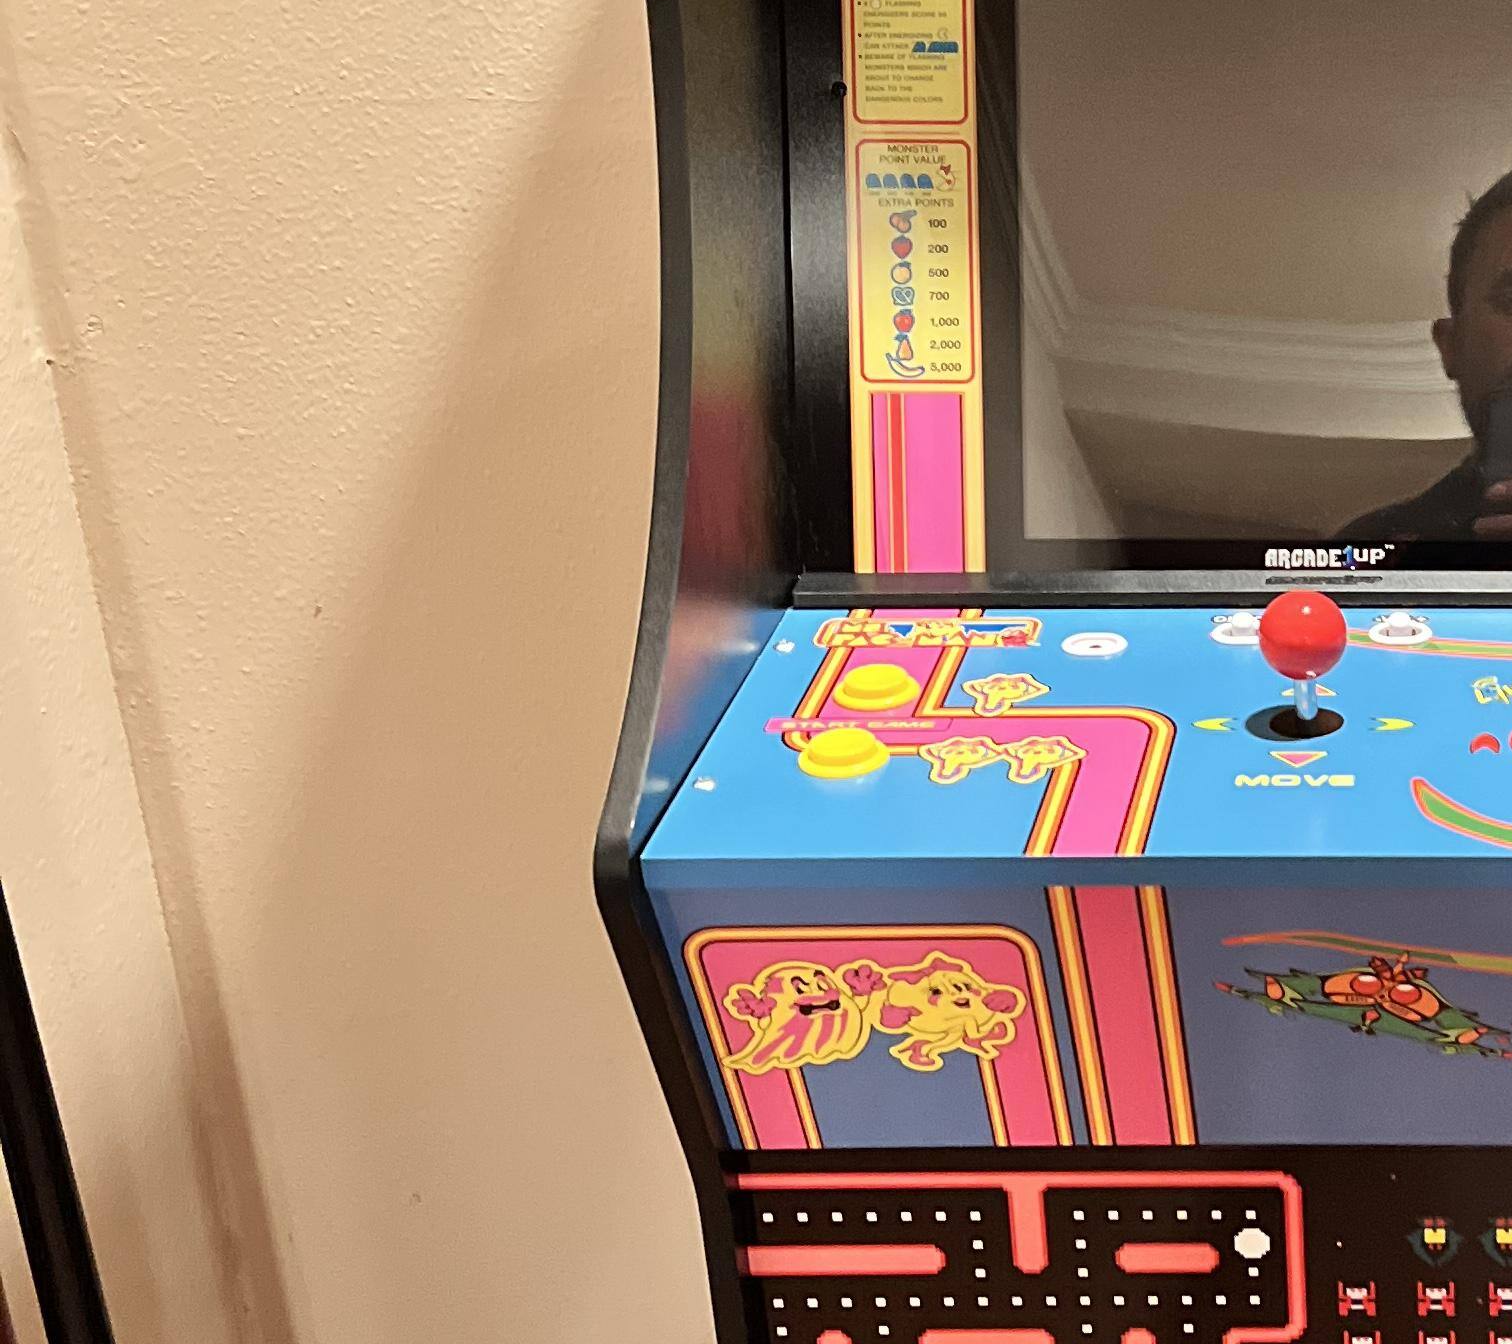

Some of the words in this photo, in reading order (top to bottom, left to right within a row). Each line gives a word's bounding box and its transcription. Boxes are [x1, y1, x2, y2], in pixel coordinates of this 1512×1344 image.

[887, 144, 939, 154] MONSTER
[880, 155, 910, 165] POINT
[913, 155, 945, 165] VALUE
[878, 198, 912, 208] EXTRA
[915, 198, 954, 208] POINTS
[928, 218, 947, 228] 100
[928, 244, 949, 254] 200
[929, 268, 949, 278] 500
[929, 291, 950, 301] 700
[930, 317, 960, 328] 1,000
[1235, 774, 1356, 787] MOVE
